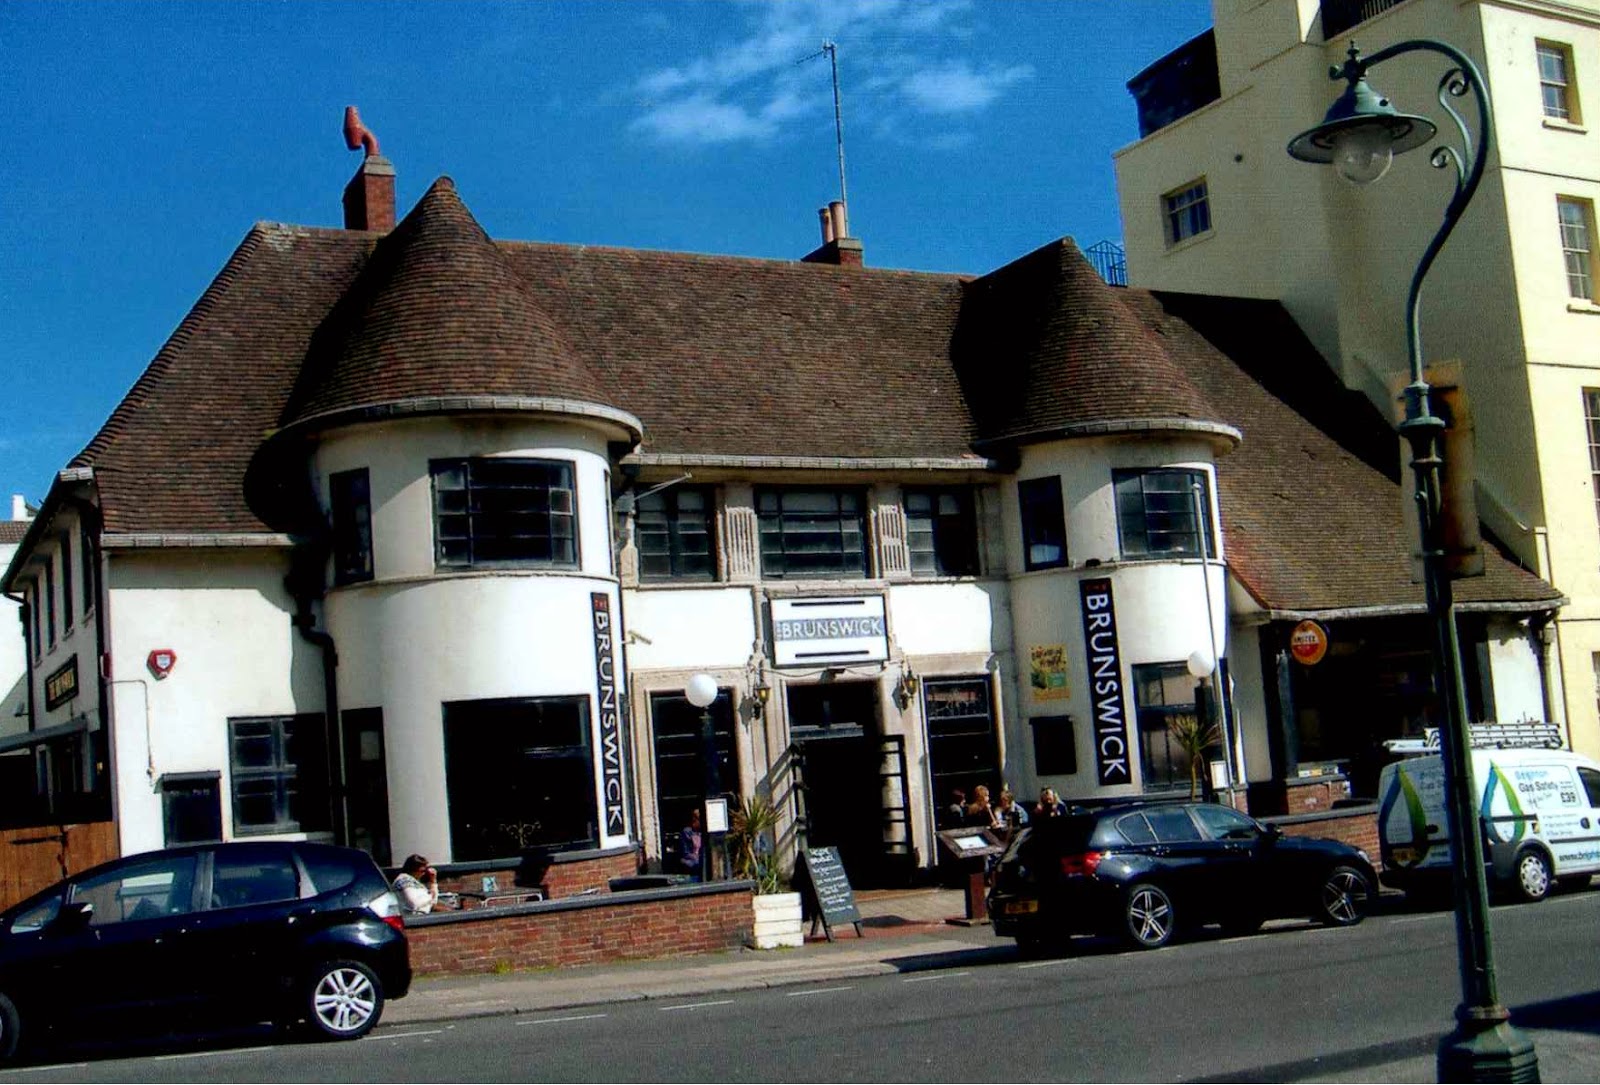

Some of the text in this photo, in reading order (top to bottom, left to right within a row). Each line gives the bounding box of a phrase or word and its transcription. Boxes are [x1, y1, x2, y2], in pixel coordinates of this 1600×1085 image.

[782, 619, 882, 638] BRUNSWICK
[595, 611, 623, 828] BRUNSWICK
[1086, 594, 1127, 778] BRUNSWICK
[1518, 782, 1534, 792] Gas
